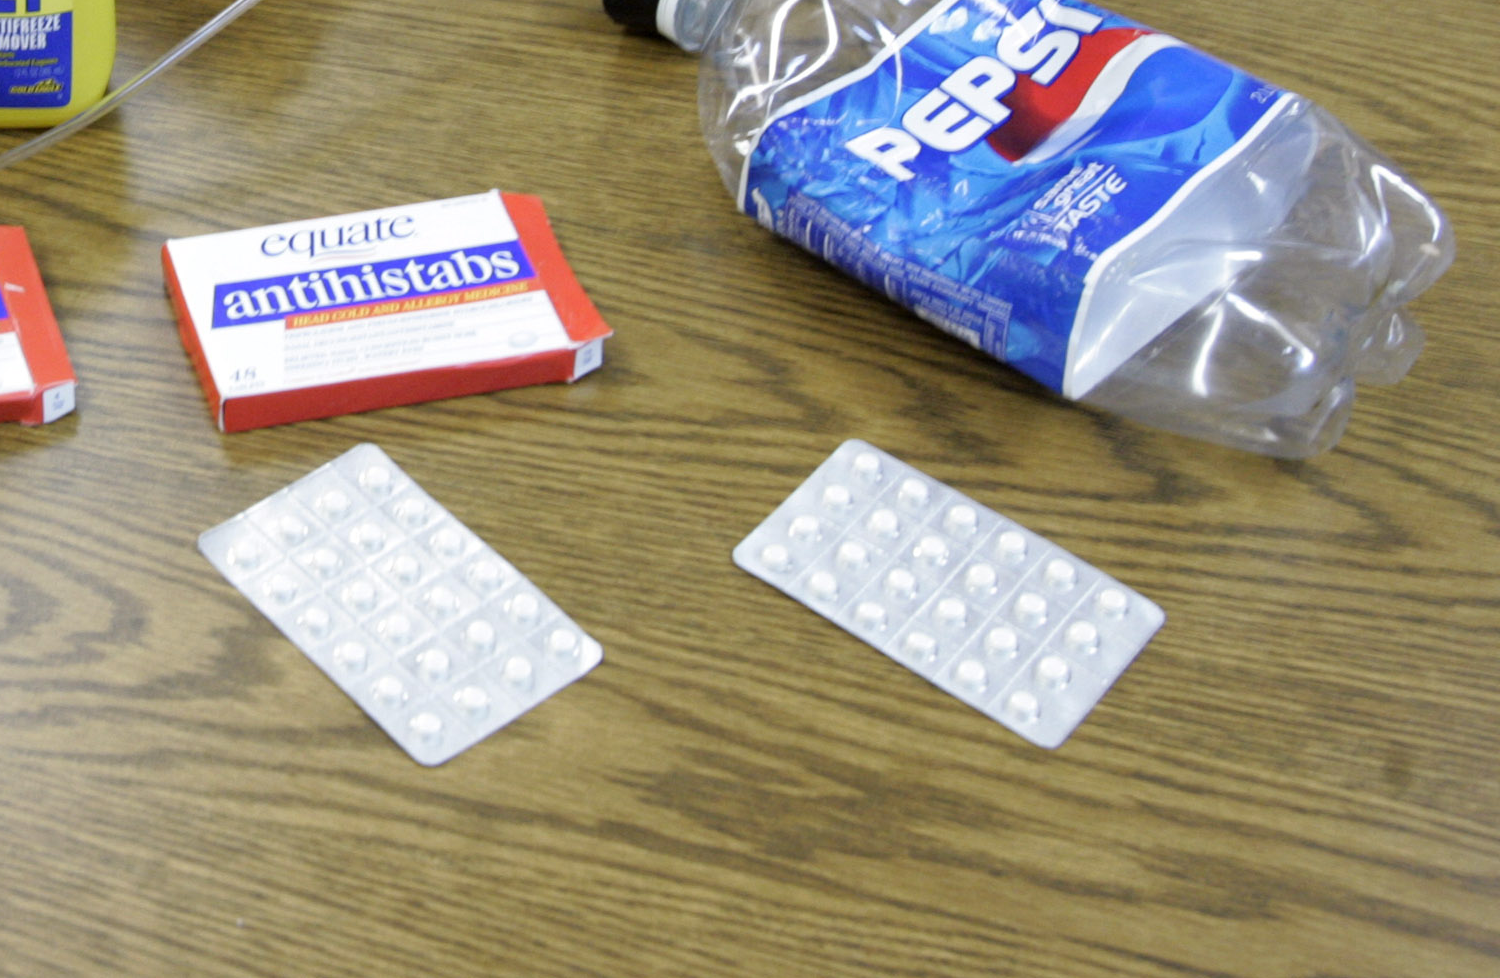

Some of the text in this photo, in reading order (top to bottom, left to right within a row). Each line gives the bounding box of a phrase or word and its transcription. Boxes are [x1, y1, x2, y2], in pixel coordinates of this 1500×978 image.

[1053, 161, 1105, 208] great
[1053, 172, 1128, 234] TASTE
[260, 213, 415, 259] equate
[223, 248, 520, 322] antihistabs
[293, 312, 331, 327] HEAD
[332, 308, 371, 324] COLD
[372, 303, 401, 318] AND
